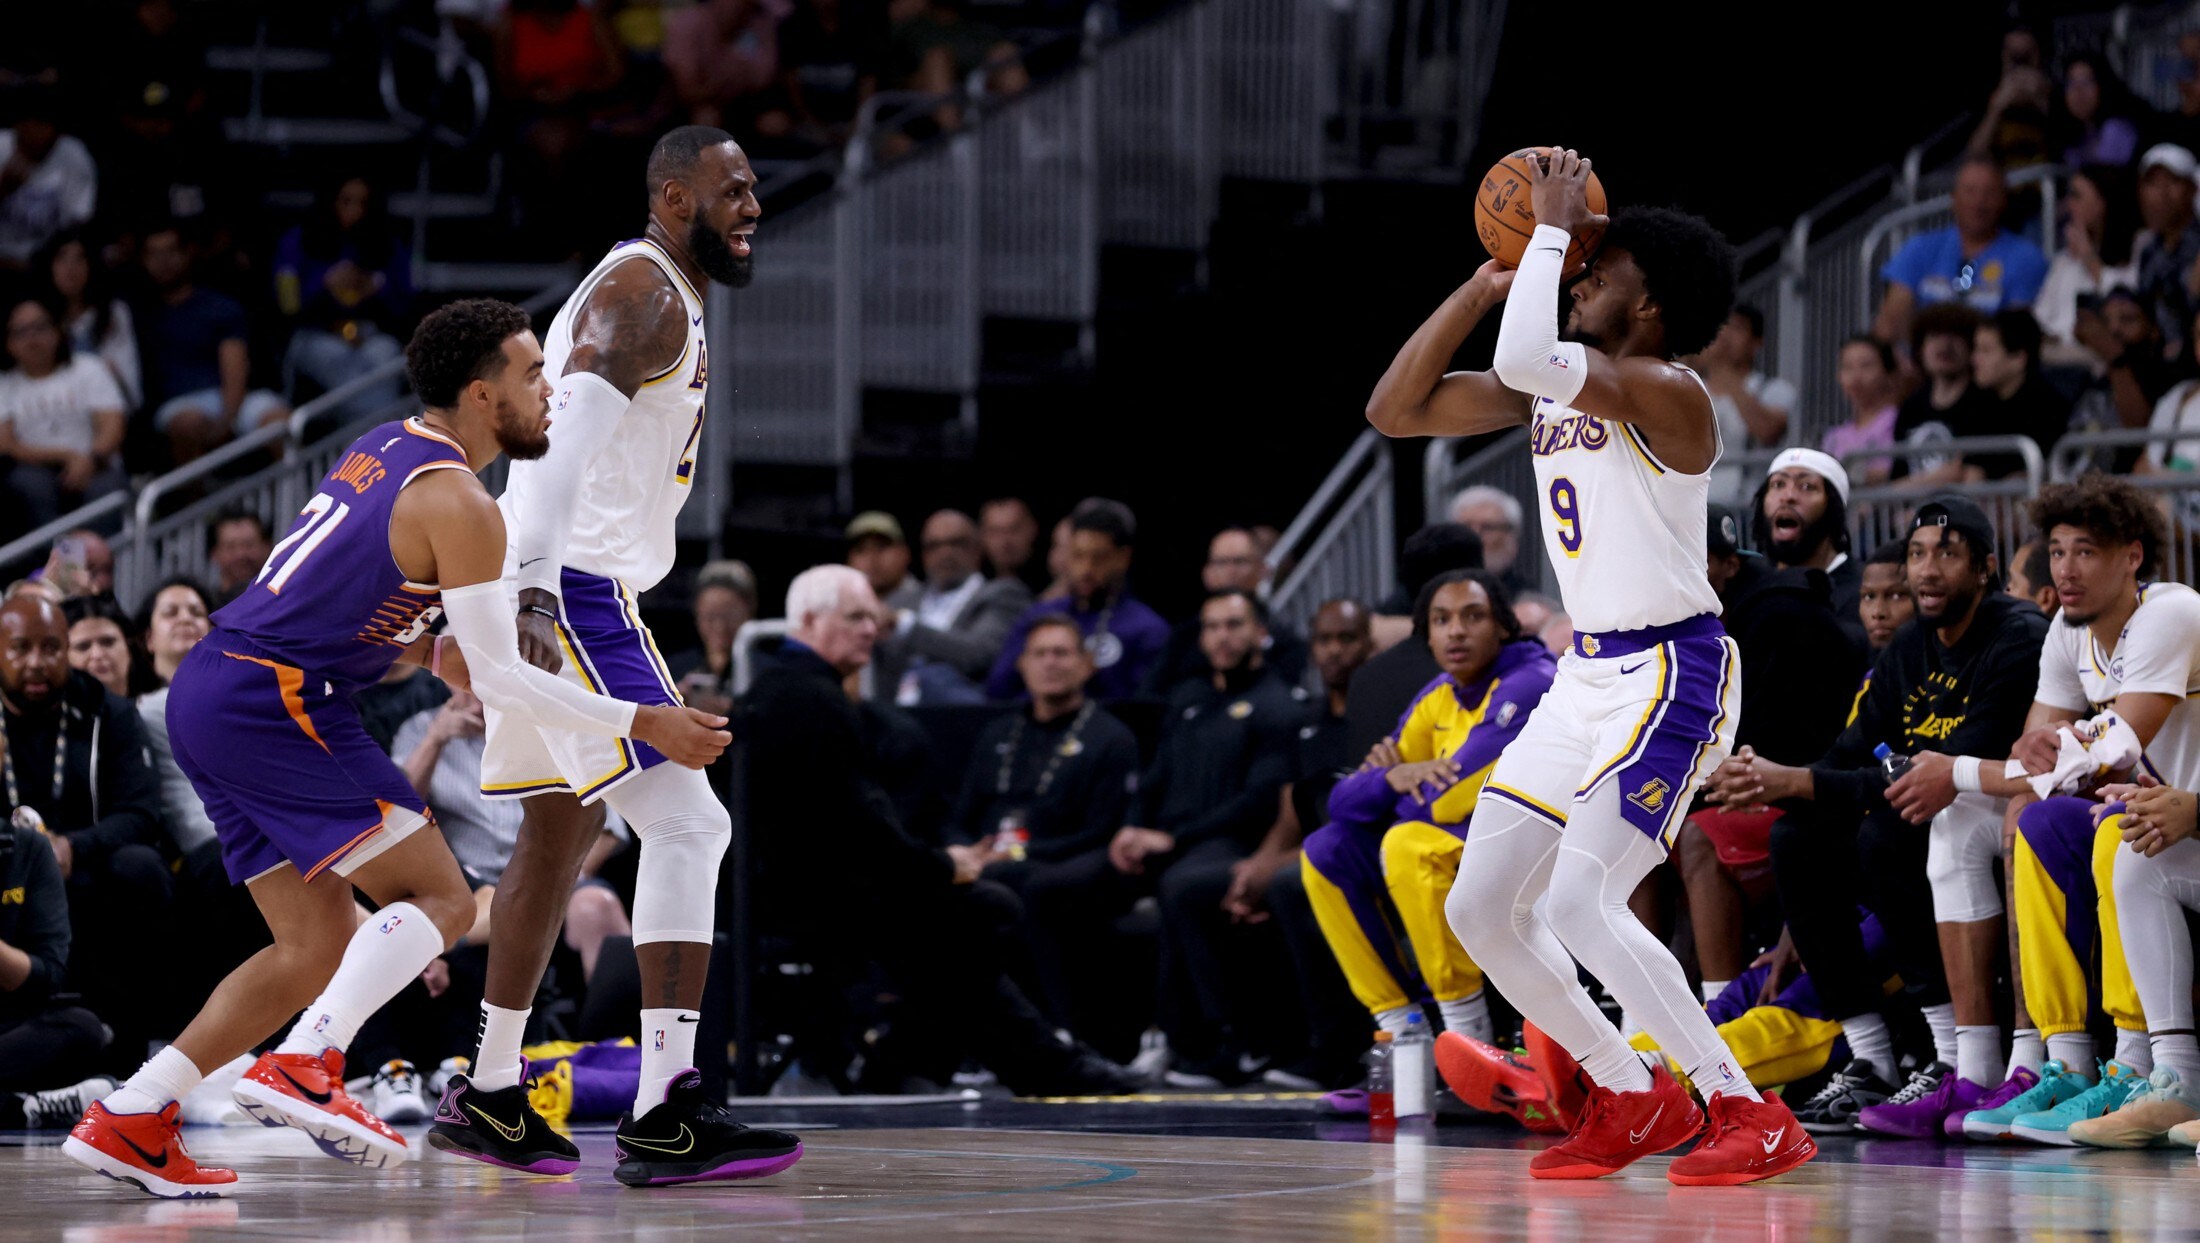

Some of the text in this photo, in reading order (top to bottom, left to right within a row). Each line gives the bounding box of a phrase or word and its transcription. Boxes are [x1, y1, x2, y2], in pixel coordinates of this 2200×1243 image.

[330, 451, 386, 494] JONES
[675, 404, 705, 486] 2
[254, 491, 350, 596] 21
[1549, 475, 1584, 559] 9
